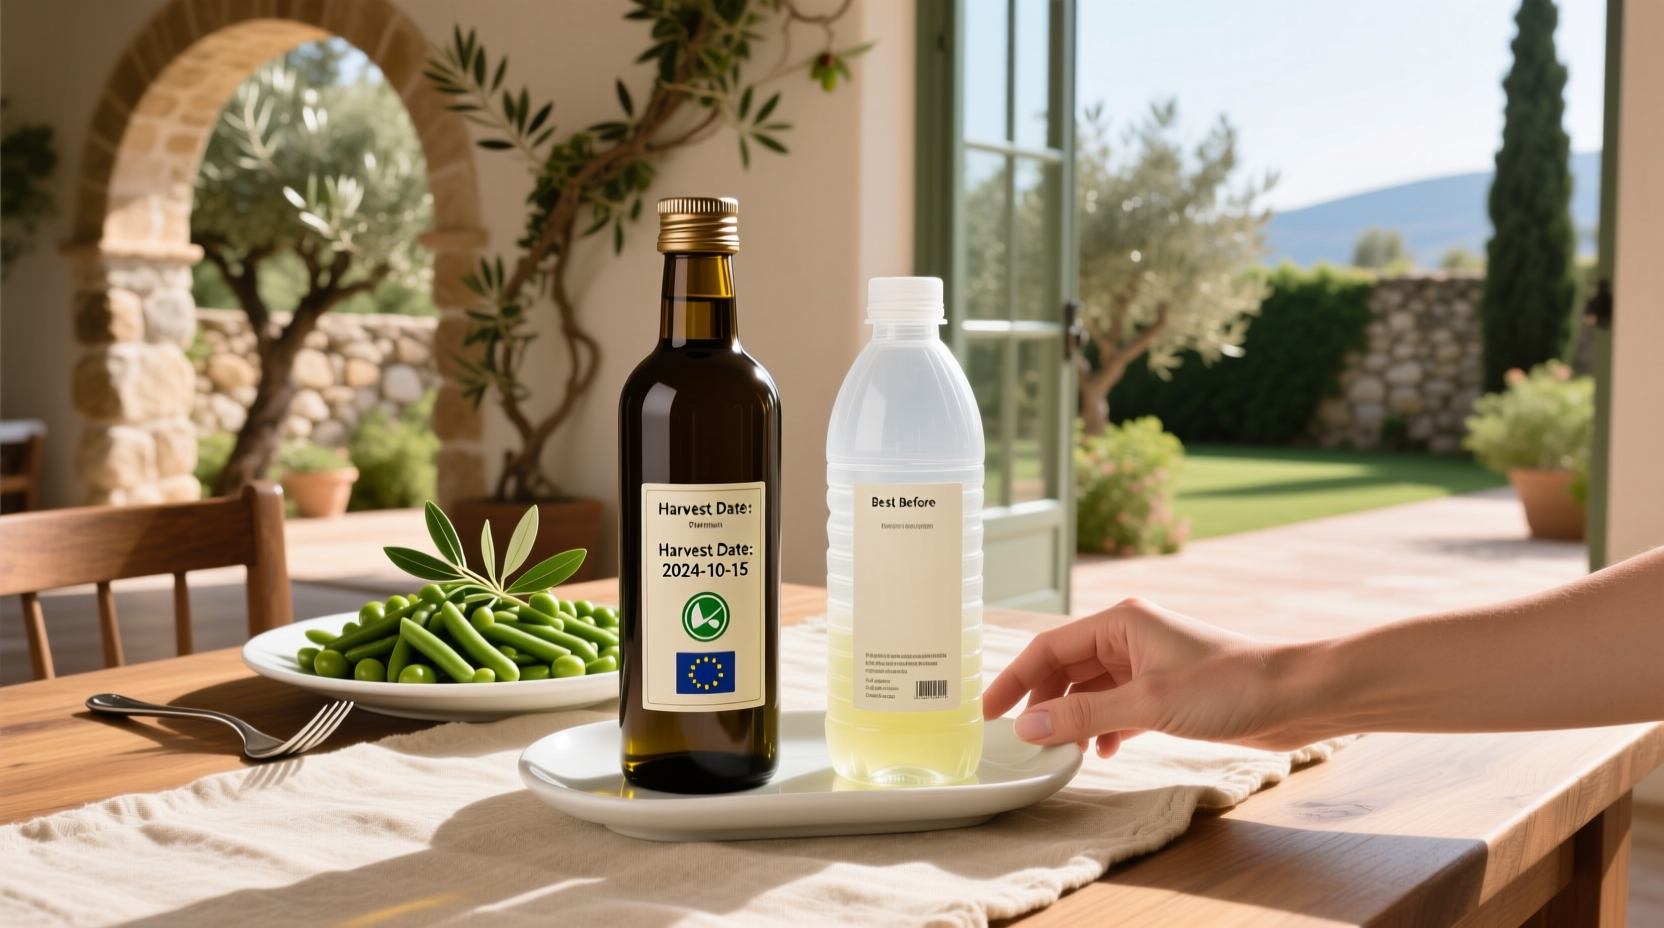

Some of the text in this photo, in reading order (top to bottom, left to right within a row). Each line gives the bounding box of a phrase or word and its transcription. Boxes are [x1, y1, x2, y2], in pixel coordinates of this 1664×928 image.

[658, 501, 752, 516] Harvest Date:
[871, 496, 936, 508] Best Before
[658, 542, 753, 557] Harvest Date:
[662, 561, 749, 578] 2024-10-15
